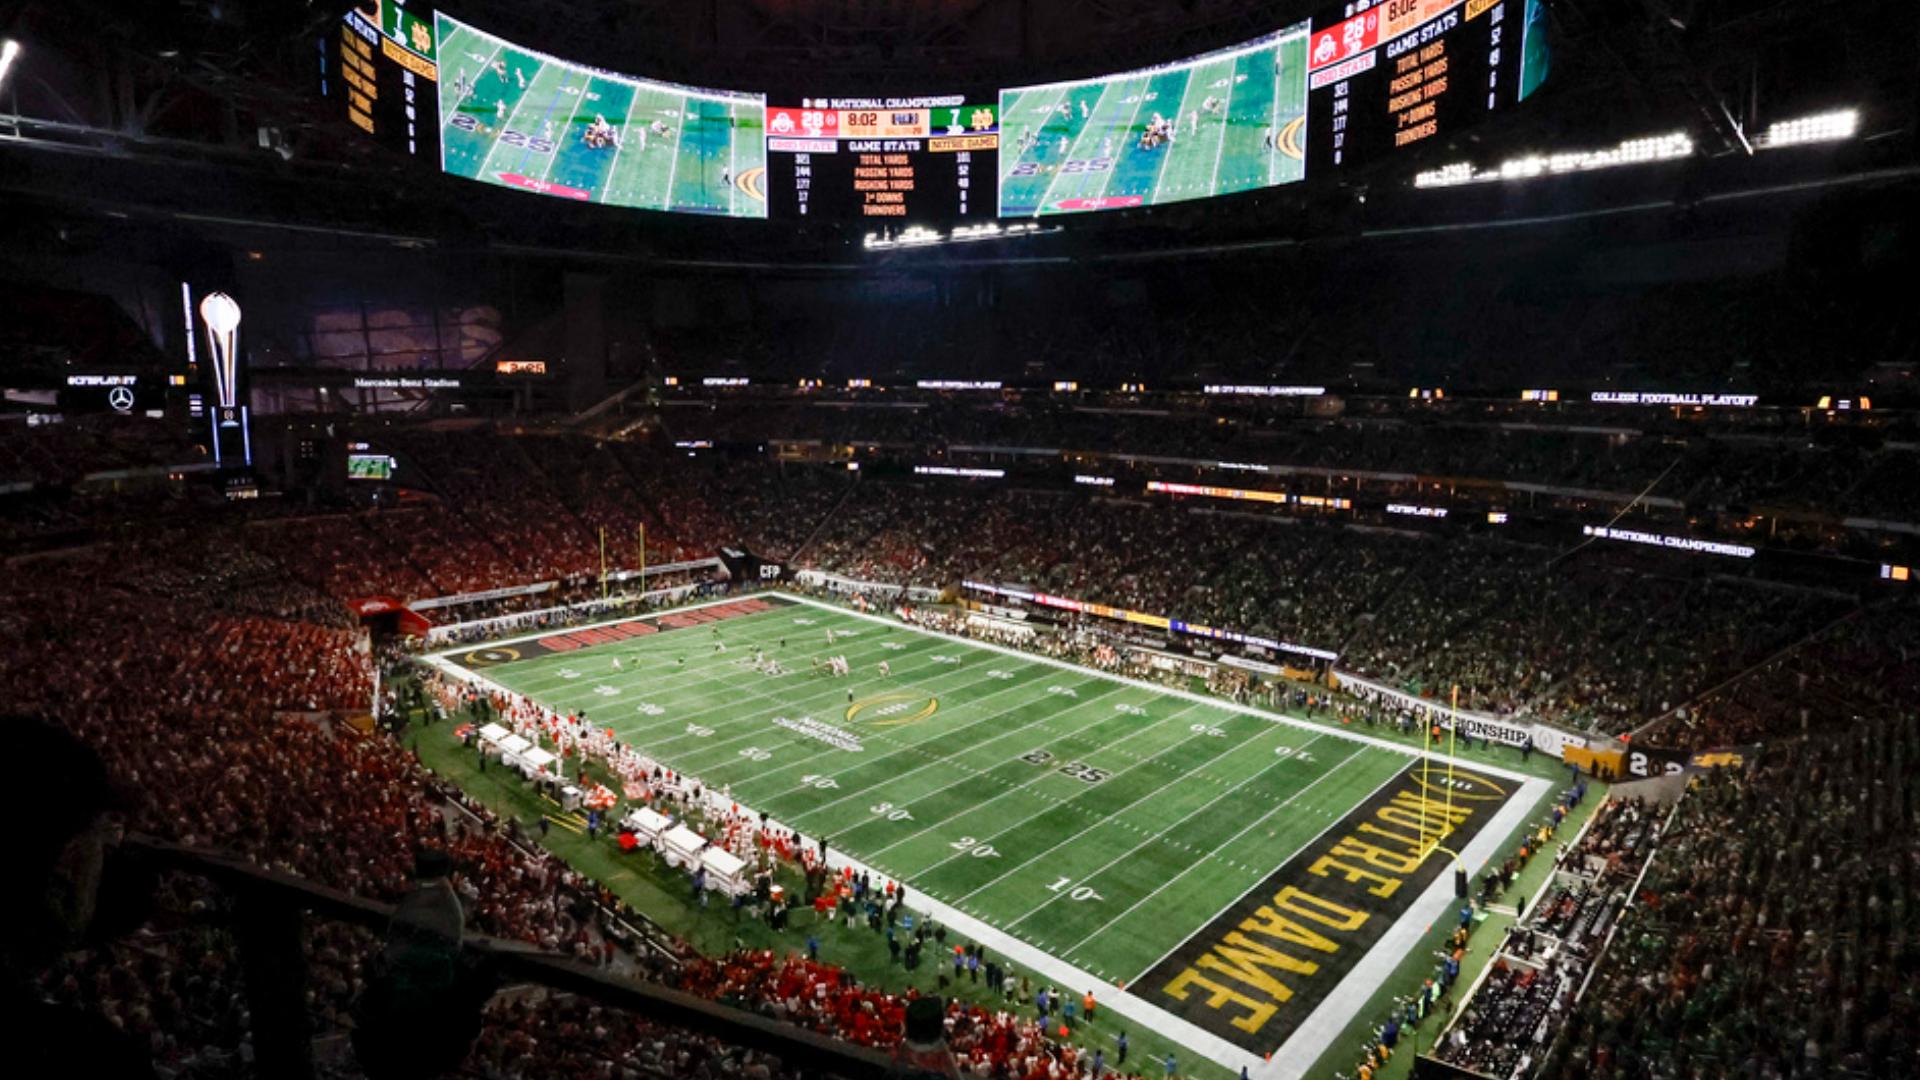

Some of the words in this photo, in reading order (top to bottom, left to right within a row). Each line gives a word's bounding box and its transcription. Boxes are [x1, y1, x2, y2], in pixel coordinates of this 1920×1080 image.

[1387, 31, 1419, 58] GAME
[1420, 10, 1458, 42] STATS
[831, 98, 885, 109] NATIONAL
[885, 95, 965, 108] CHAMPIONSHIP
[801, 111, 824, 128] 28
[950, 108, 961, 127] 7
[848, 141, 881, 152] GAME
[883, 141, 921, 152] STATS
[860, 154, 883, 165] TOTAL
[884, 154, 908, 165] YARDS
[855, 167, 888, 178] PASSING
[889, 167, 914, 178] YARDS
[890, 180, 915, 190] YARDS
[876, 192, 903, 203] DOWNS
[863, 204, 906, 215] TURNOVERS
[354, 378, 423, 387] Mercedes-Benz
[424, 378, 460, 387] Stadium
[1591, 392, 1639, 402] COLLEGE
[1641, 393, 1700, 404] FOOTBALL
[1701, 394, 1758, 405] PLAYOFF
[1609, 527, 1663, 545] NATIONAL
[1664, 536, 1755, 557] CHAMPIONSHIP
[759, 564, 781, 578] CFP
[870, 802, 909, 822] 30
[949, 836, 993, 858] 20
[1307, 789, 1474, 899] NOTRE
[1045, 876, 1094, 901] 10
[1161, 884, 1371, 1035] DAME
